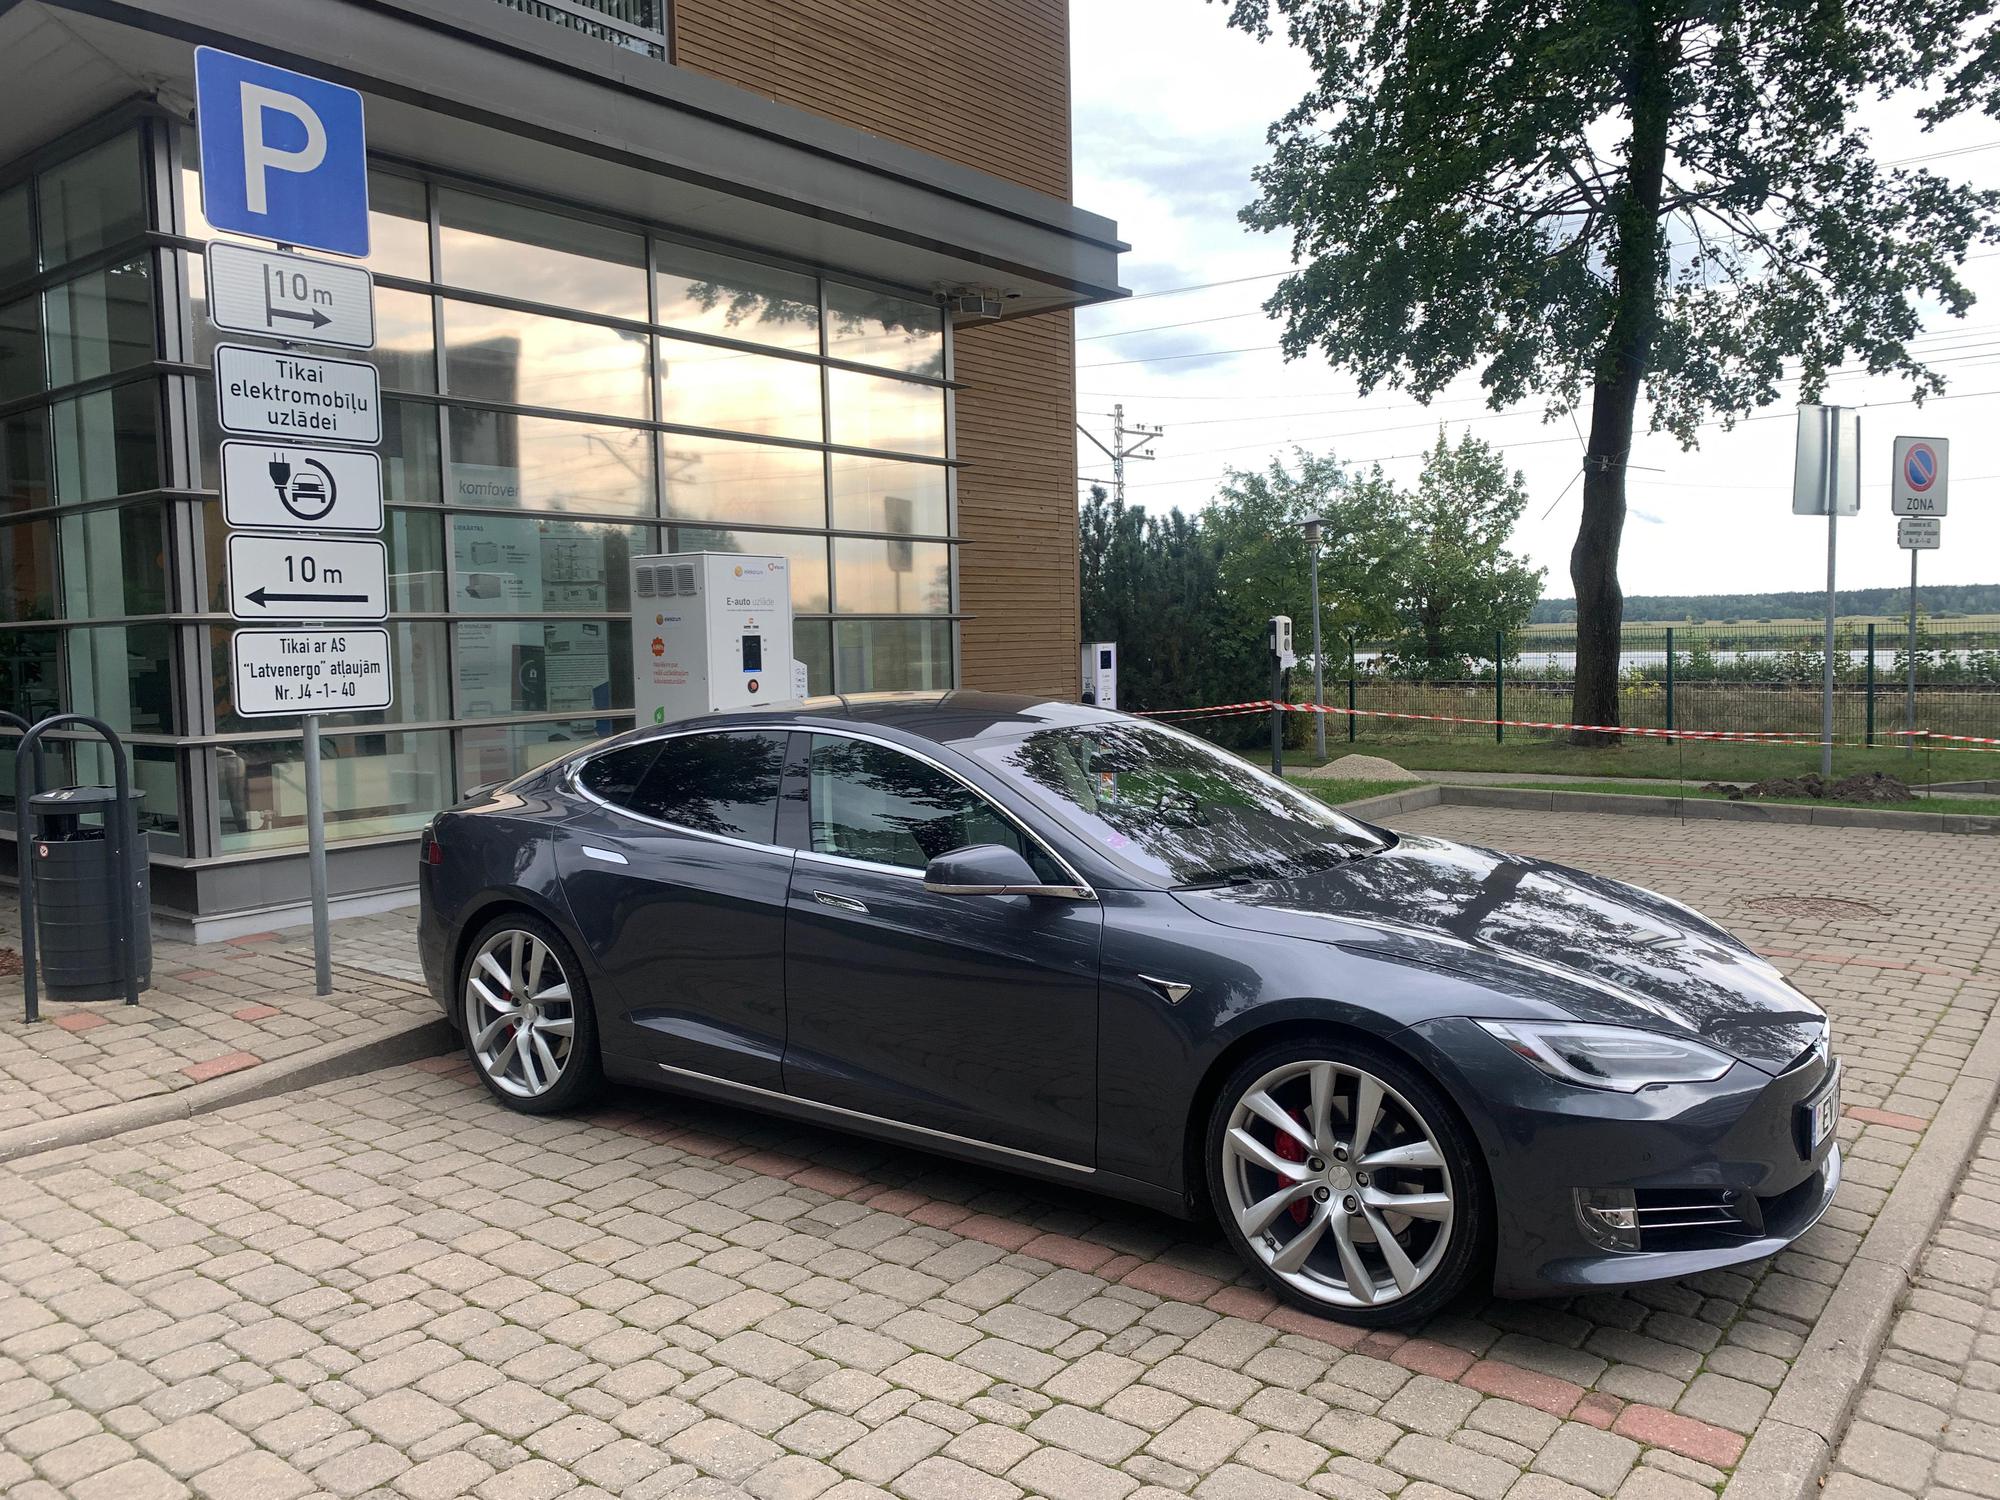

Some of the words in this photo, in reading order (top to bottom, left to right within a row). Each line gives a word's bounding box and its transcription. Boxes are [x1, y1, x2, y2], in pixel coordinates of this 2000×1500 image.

[239, 80, 327, 215] P
[275, 270, 308, 300] 10
[313, 288, 333, 305] m
[275, 359, 323, 384] Tikai
[230, 379, 368, 414] elektromobīļu
[267, 409, 337, 431] uzlādei
[1907, 498, 1935, 510] ZONA
[285, 555, 316, 583] 10
[323, 568, 343, 584] m
[726, 597, 751, 606] E-auto
[279, 638, 310, 654] Tikai
[314, 641, 327, 653] ar
[330, 637, 346, 653] AS
[330, 660, 381, 678] atļaujām
[275, 685, 294, 701] Nr.
